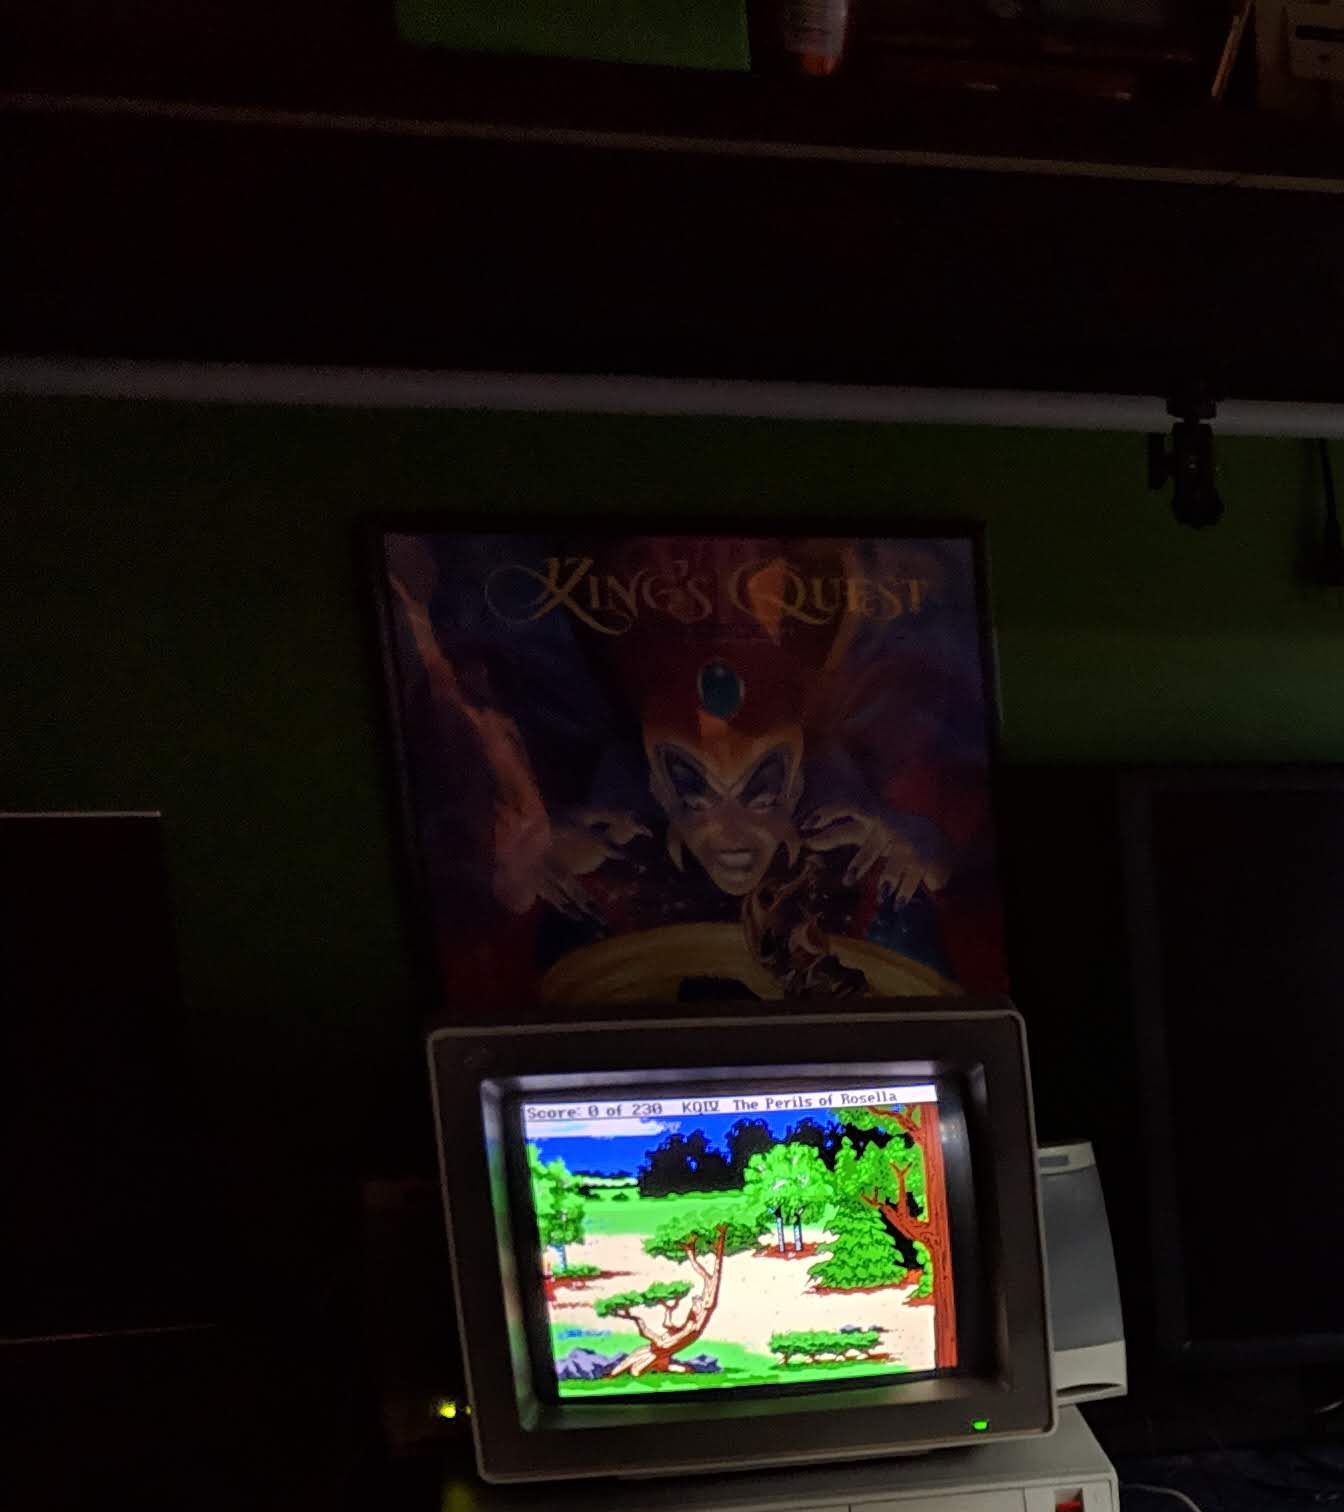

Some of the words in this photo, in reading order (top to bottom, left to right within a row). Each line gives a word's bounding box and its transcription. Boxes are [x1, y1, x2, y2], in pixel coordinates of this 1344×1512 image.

[526, 1106, 582, 1120] Score:
[587, 1104, 600, 1118] 0
[605, 1103, 623, 1117] of
[631, 1102, 664, 1116] 230
[733, 1098, 759, 1111] The
[766, 1095, 813, 1109] Perils
[819, 1093, 833, 1107] of
[841, 1090, 898, 1105] Rosella
